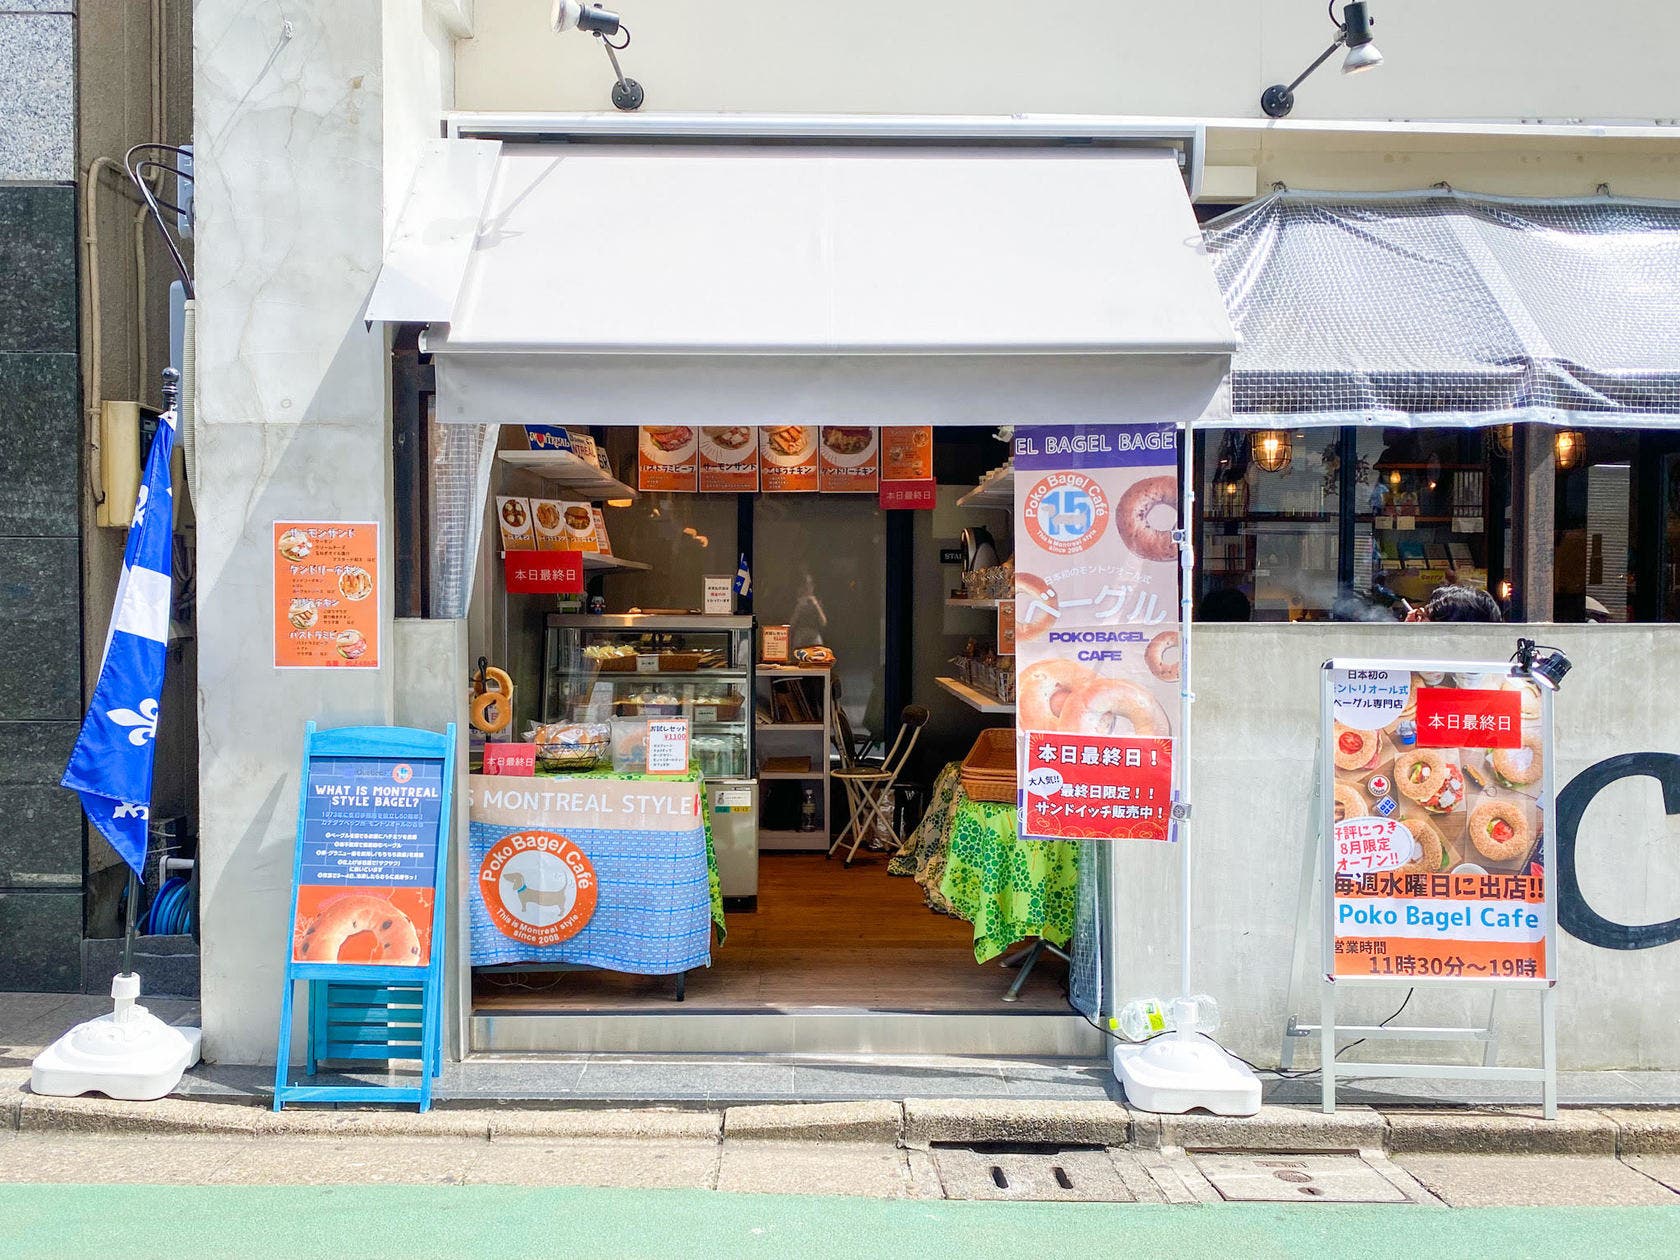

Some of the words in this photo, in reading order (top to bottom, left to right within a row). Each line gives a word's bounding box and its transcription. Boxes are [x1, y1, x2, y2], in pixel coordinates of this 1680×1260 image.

[1046, 434, 1112, 454] BAGEL
[1118, 431, 1177, 451] BAGE
[887, 490, 931, 500] 本日最終日
[1025, 485, 1047, 518] Poko
[1047, 474, 1090, 488] Bagel
[515, 569, 576, 582] 本日最終日
[1024, 584, 1167, 625] ベーグル
[1077, 650, 1123, 661] CAFE
[1348, 669, 1388, 680] 日本初の
[1334, 684, 1408, 695] ントリオール式
[1428, 712, 1511, 732] 本日最終日
[487, 757, 533, 767] 本日最終日
[1037, 743, 1158, 768] 本日最終日！
[315, 785, 351, 796] WHAT
[355, 785, 368, 796] IS
[373, 786, 439, 798] MONTREAL
[332, 796, 370, 807] STYLE
[374, 797, 420, 808] BAGEL?
[483, 790, 614, 814] MONTREAL
[621, 795, 692, 816] STYLE
[1035, 801, 1163, 820] サンドイッチ販売中！
[1340, 837, 1391, 855] 8月限定
[482, 846, 513, 882] Poko
[511, 835, 568, 854] Bagel
[565, 850, 593, 889] Café
[496, 908, 512, 924] This
[520, 923, 559, 935] Montreal
[559, 914, 579, 930] style
[1339, 904, 1398, 925] Poko
[1406, 905, 1472, 931] Bagel
[1480, 907, 1539, 929] Cafe
[513, 929, 537, 942] since
[538, 933, 560, 944] 2008
[1334, 940, 1387, 955] 営業時間
